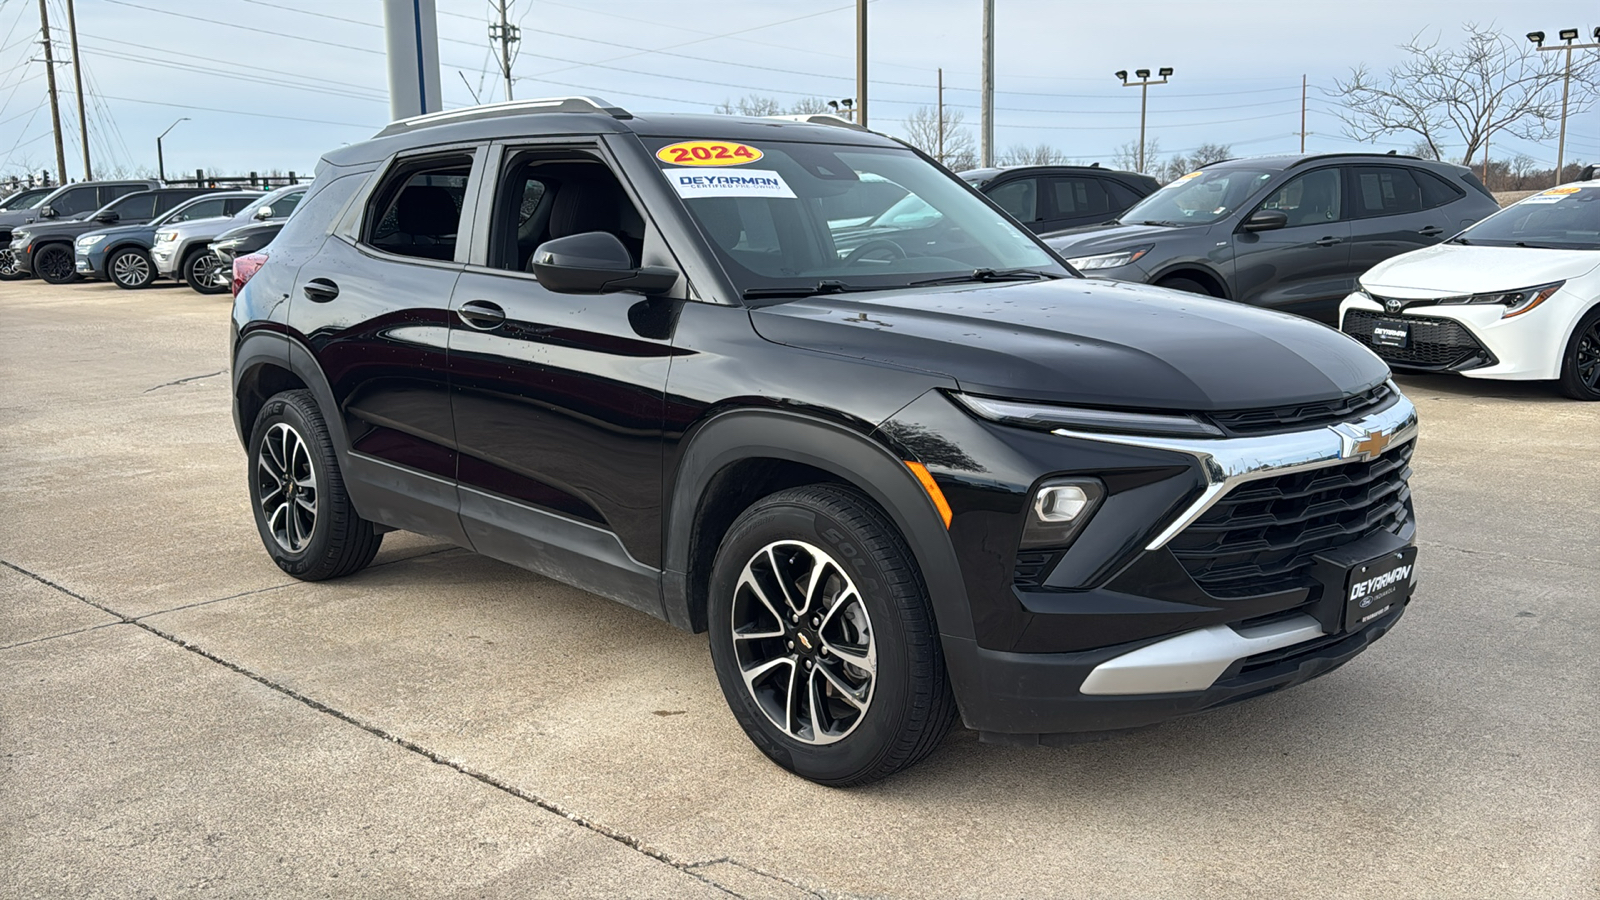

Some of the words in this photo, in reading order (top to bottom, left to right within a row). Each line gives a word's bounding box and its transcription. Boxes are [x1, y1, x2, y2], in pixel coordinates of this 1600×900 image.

[670, 146, 754, 162] 2024
[680, 176, 779, 186] DEYARMAN
[1350, 565, 1412, 601] DEYARMAN
